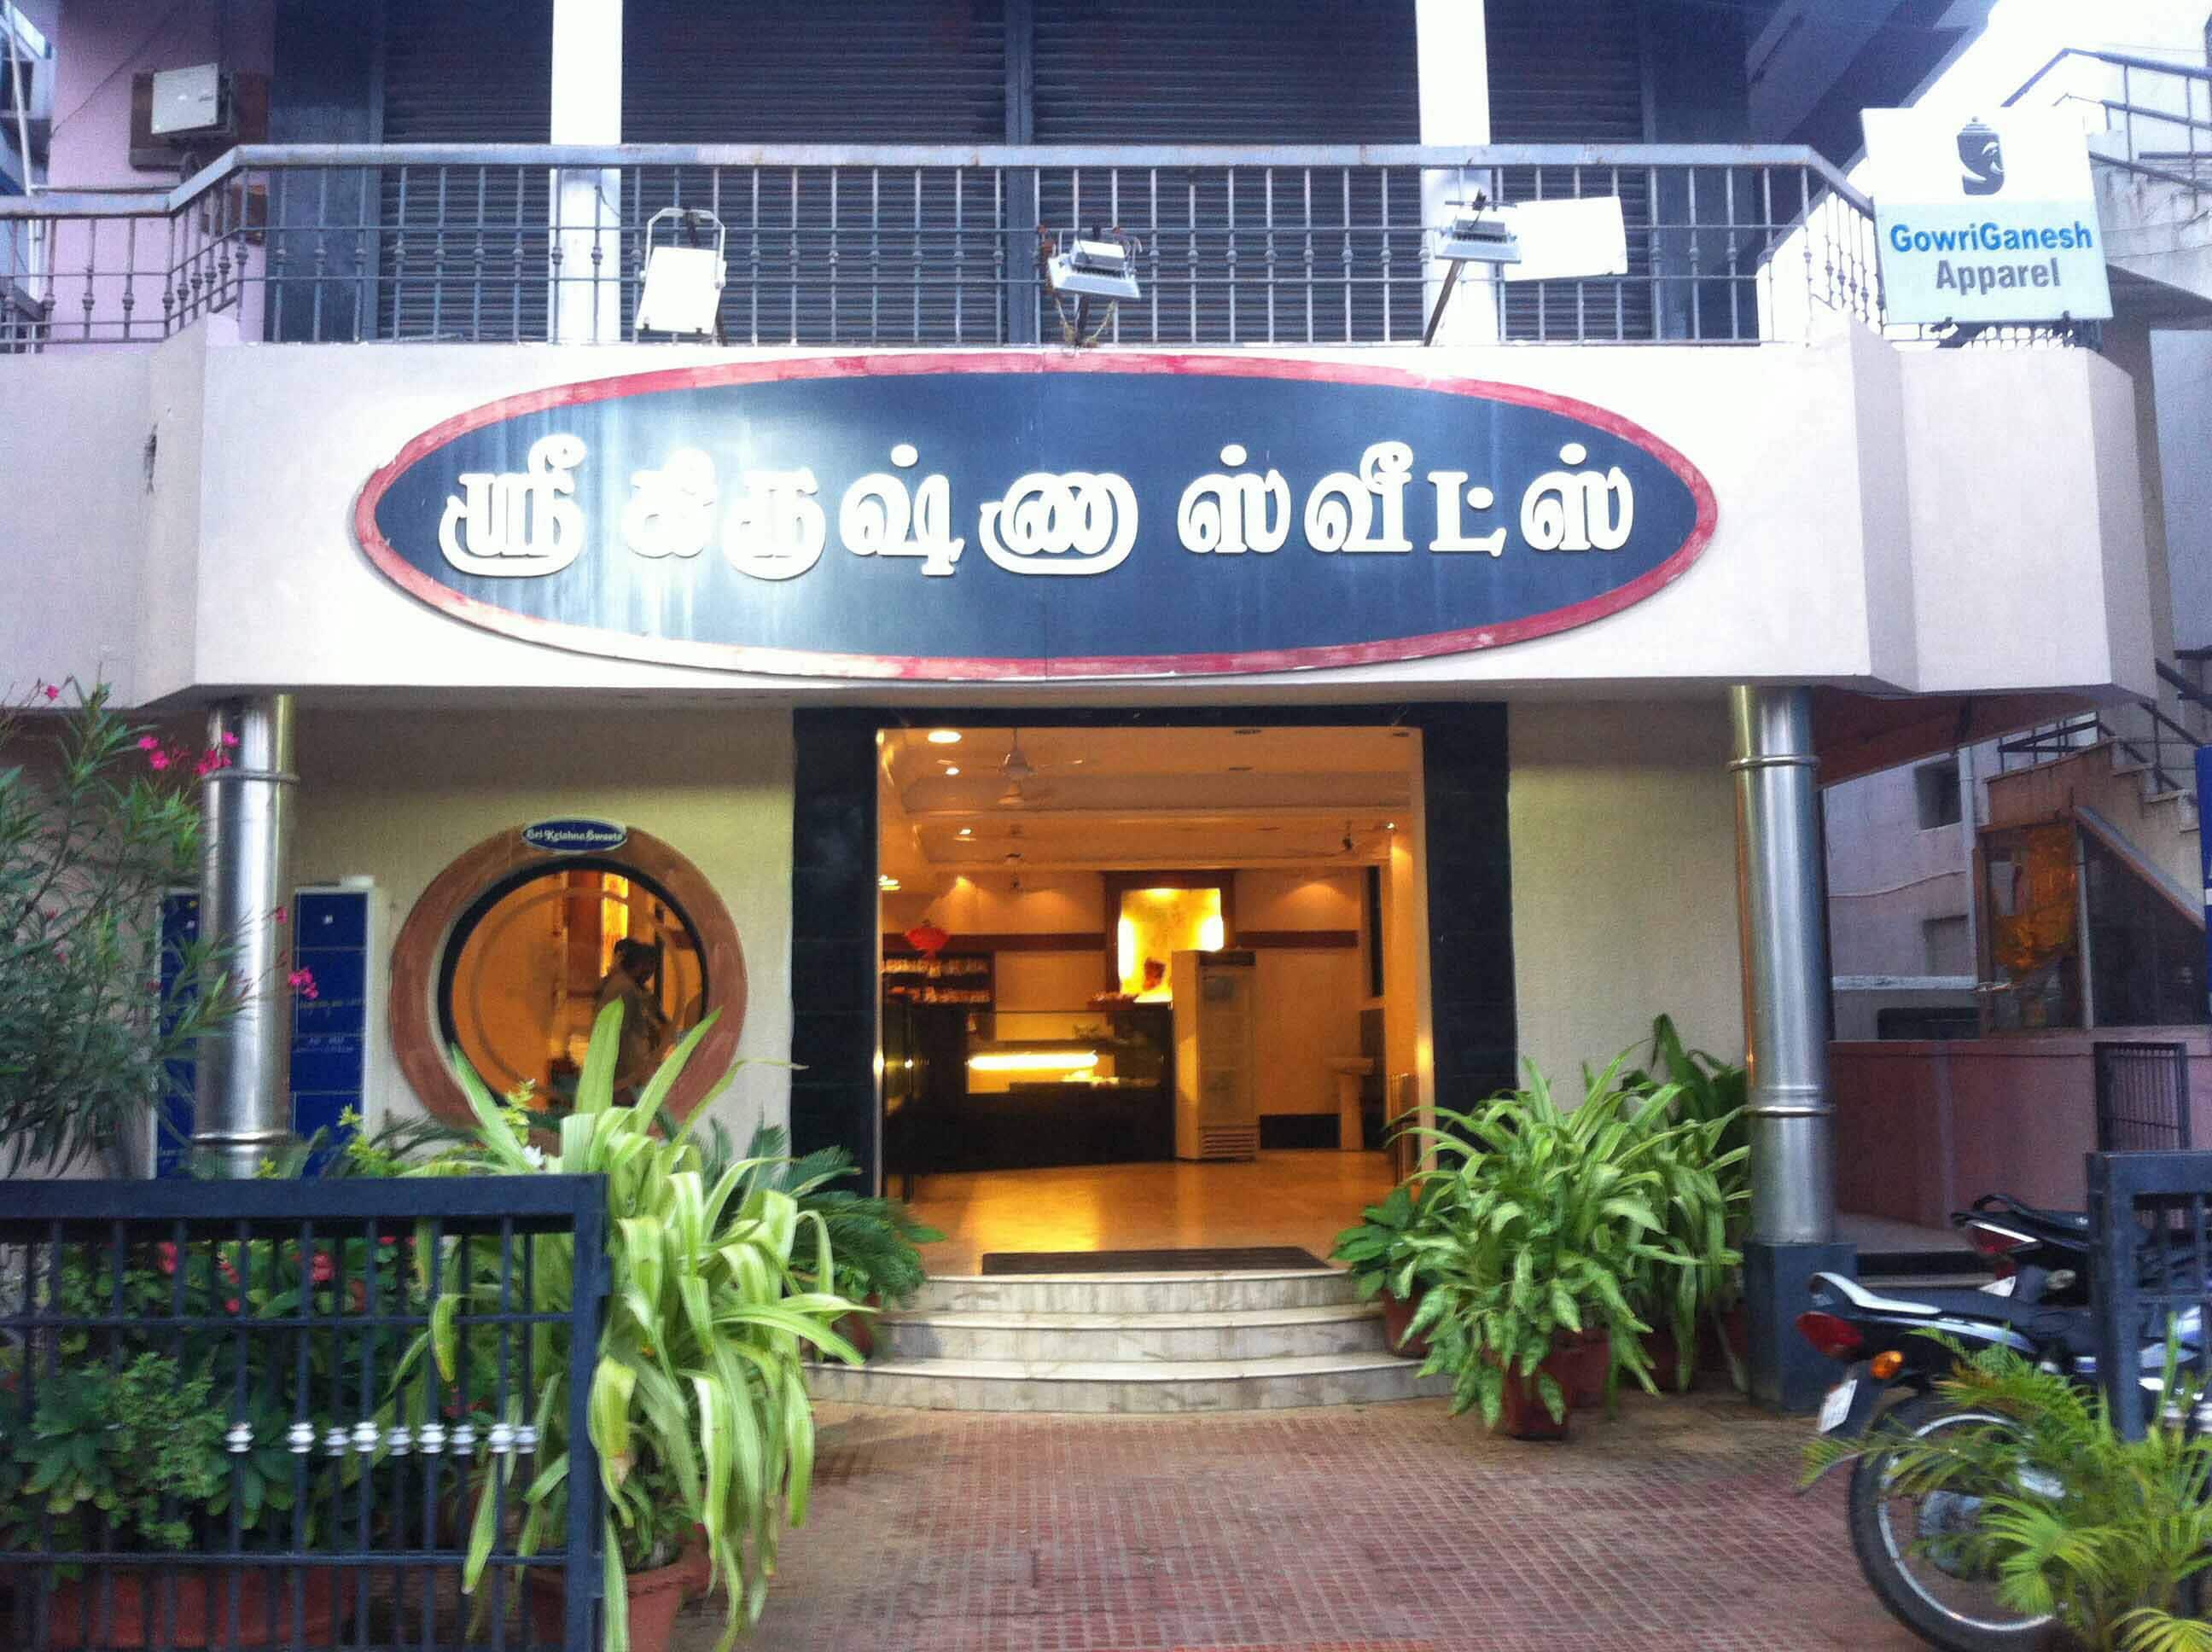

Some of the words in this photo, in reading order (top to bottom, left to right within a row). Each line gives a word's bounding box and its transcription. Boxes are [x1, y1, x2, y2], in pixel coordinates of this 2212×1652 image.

[1889, 220, 2093, 253] GowriGanesh
[1936, 258, 2061, 296] Apparel
[1178, 441, 1633, 556] ஸ்வீட்ஸ்
